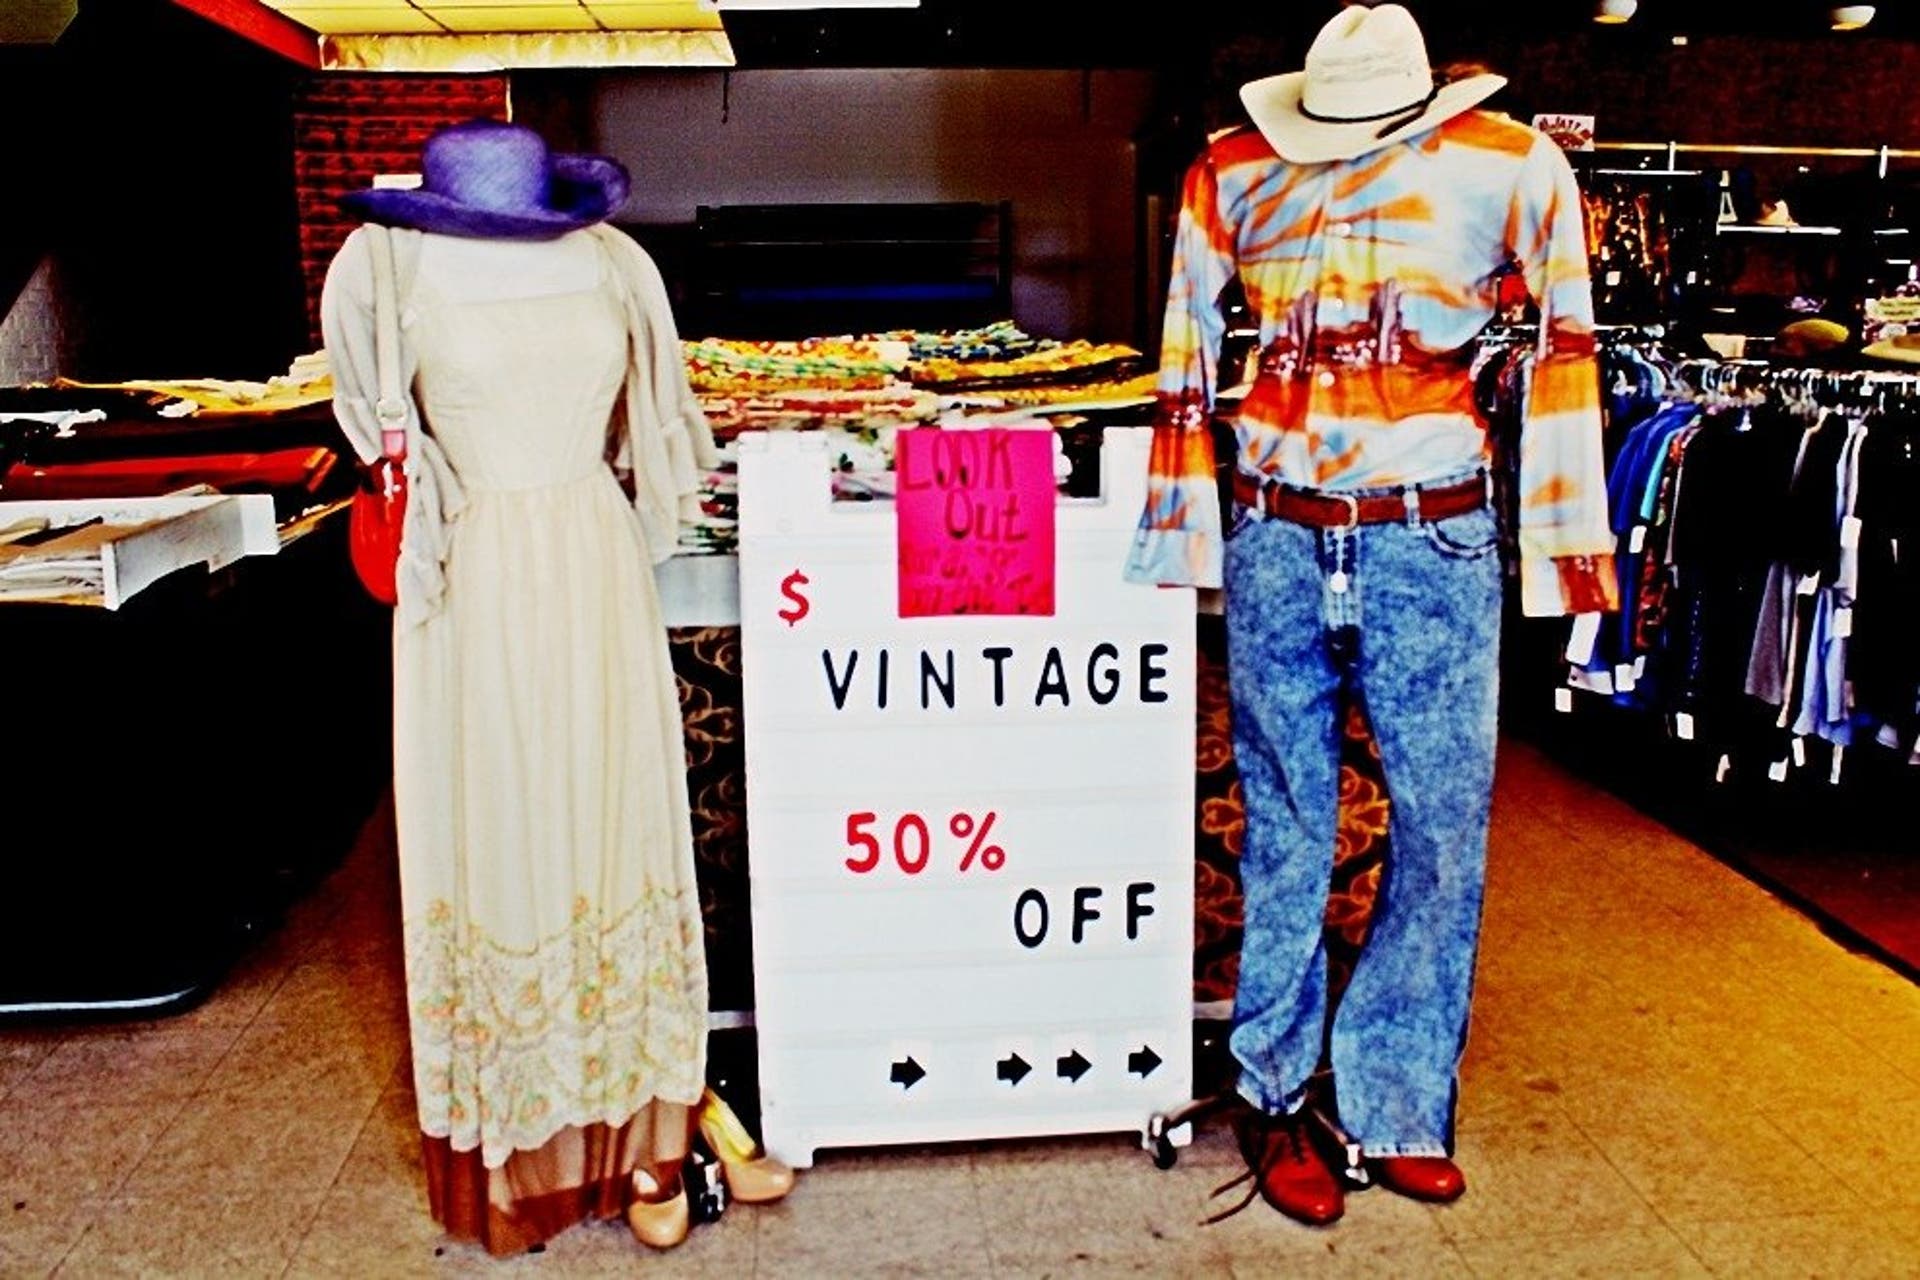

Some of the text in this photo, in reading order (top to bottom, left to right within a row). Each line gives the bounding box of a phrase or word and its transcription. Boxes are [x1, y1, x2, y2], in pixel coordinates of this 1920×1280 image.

[897, 431, 1012, 490] LOOK
[779, 570, 809, 626] $
[823, 643, 1168, 709] VINTAGE
[846, 812, 1005, 874] 50%
[1014, 883, 1154, 948] OFF
